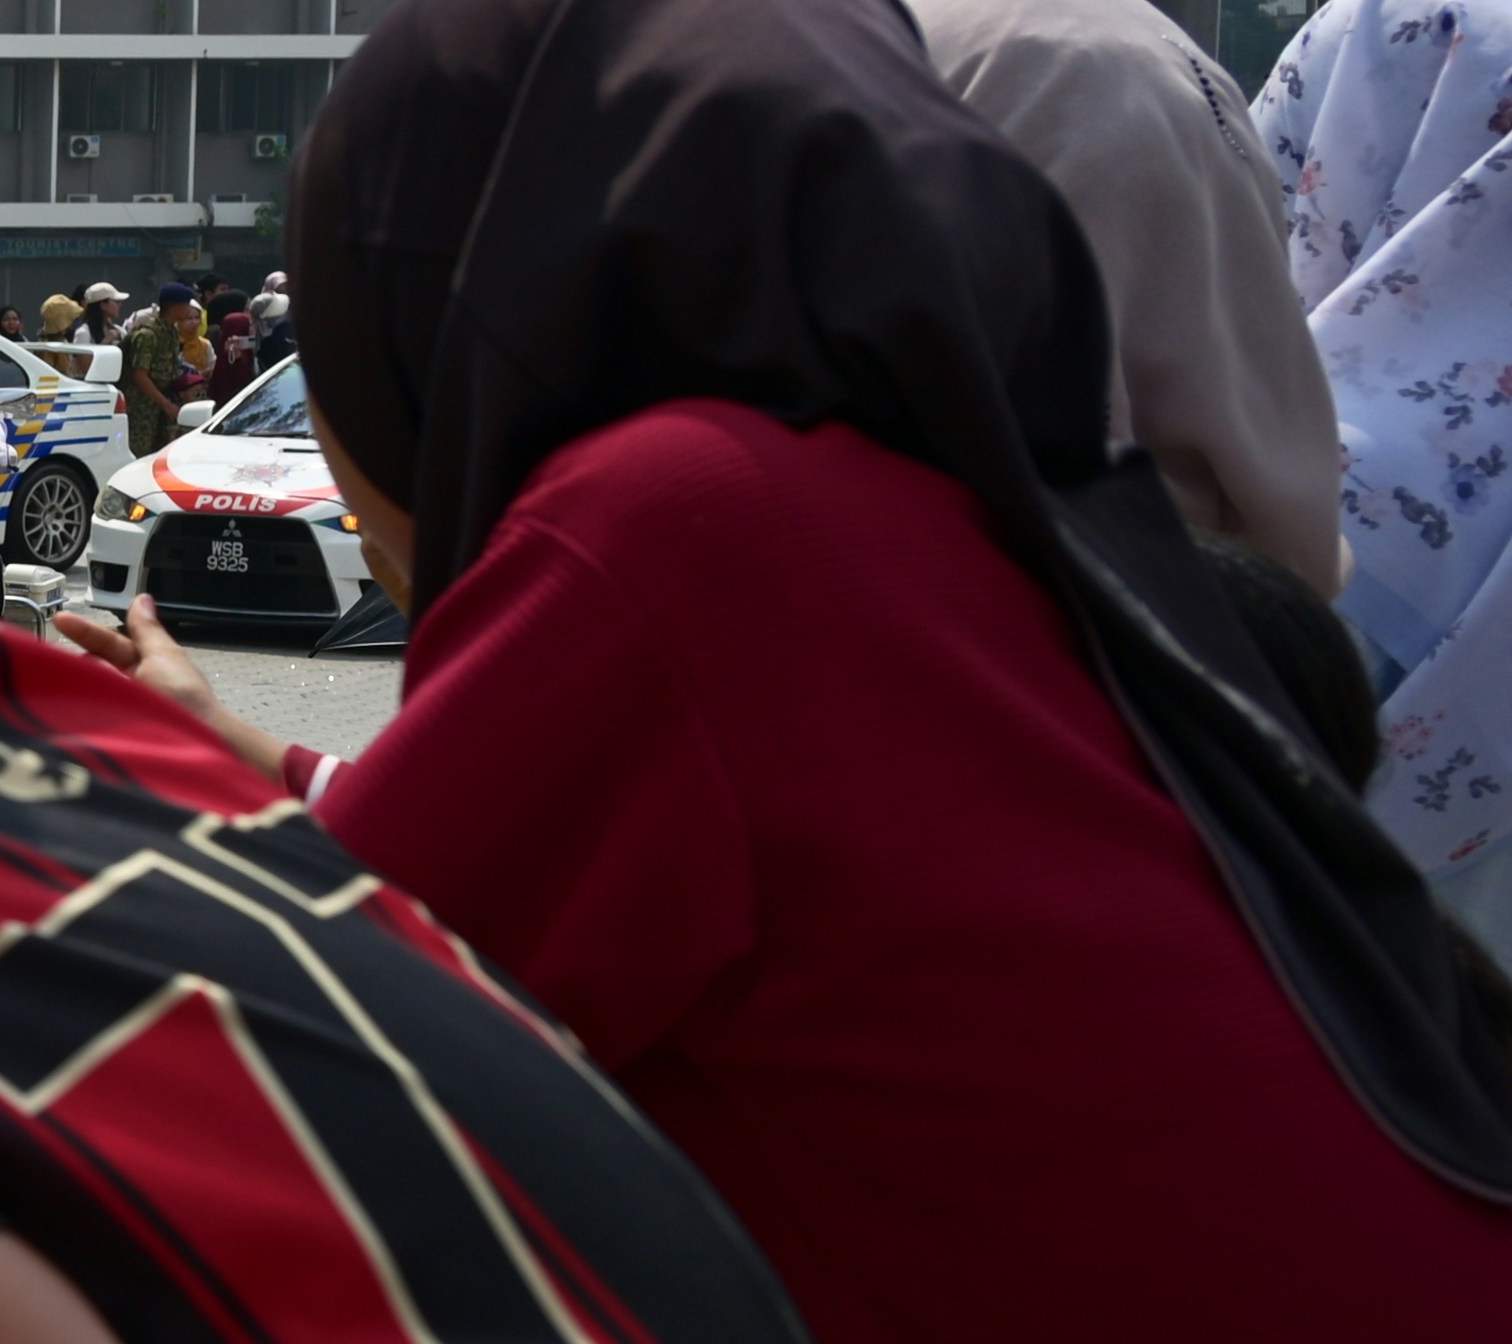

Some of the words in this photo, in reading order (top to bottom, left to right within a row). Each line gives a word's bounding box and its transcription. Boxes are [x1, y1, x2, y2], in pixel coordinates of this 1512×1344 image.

[194, 493, 277, 512] POLIS
[211, 540, 243, 556] WSB
[206, 556, 249, 572] 9325
